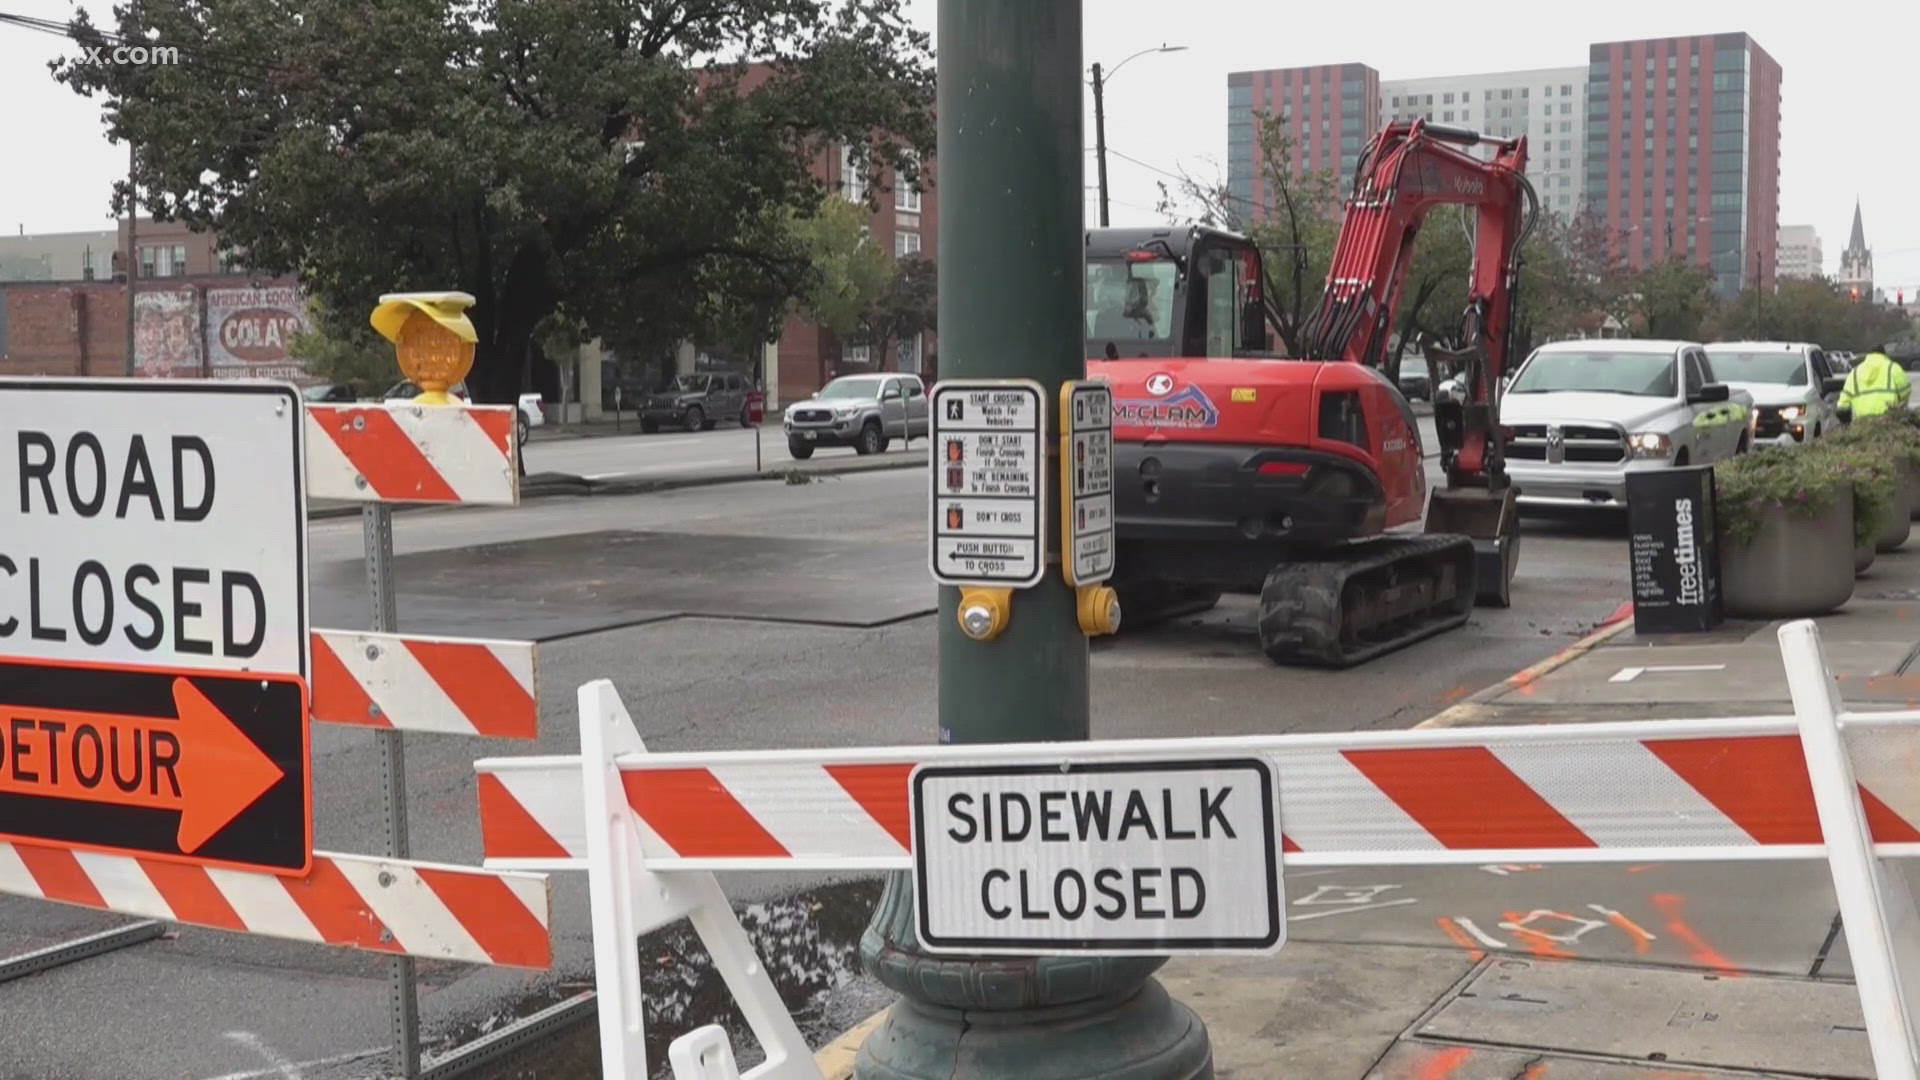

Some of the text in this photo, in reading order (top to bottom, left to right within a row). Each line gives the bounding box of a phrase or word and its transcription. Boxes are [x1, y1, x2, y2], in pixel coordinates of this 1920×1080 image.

[211, 290, 306, 306] AMERICAN COOK
[970, 394, 1025, 403] START CROSSING
[981, 406, 1002, 415] Watch
[986, 418, 1014, 426] Vehicles
[979, 435, 1021, 445] DON'T START
[976, 448, 1025, 459] Finish Crossing
[994, 459, 1018, 467] Started
[17, 430, 215, 522] ROAD
[972, 472, 1029, 482] TIME REMAINING
[971, 484, 1030, 494] To Finish Crossing
[976, 511, 1022, 522] DON'T CROSS
[957, 543, 1014, 553] PUSH BUTTON
[965, 561, 1005, 571] TO CROSS
[0, 717, 182, 799] ETOUR
[947, 786, 1237, 844] SIDEWALK
[980, 867, 1206, 921] CLOSED
